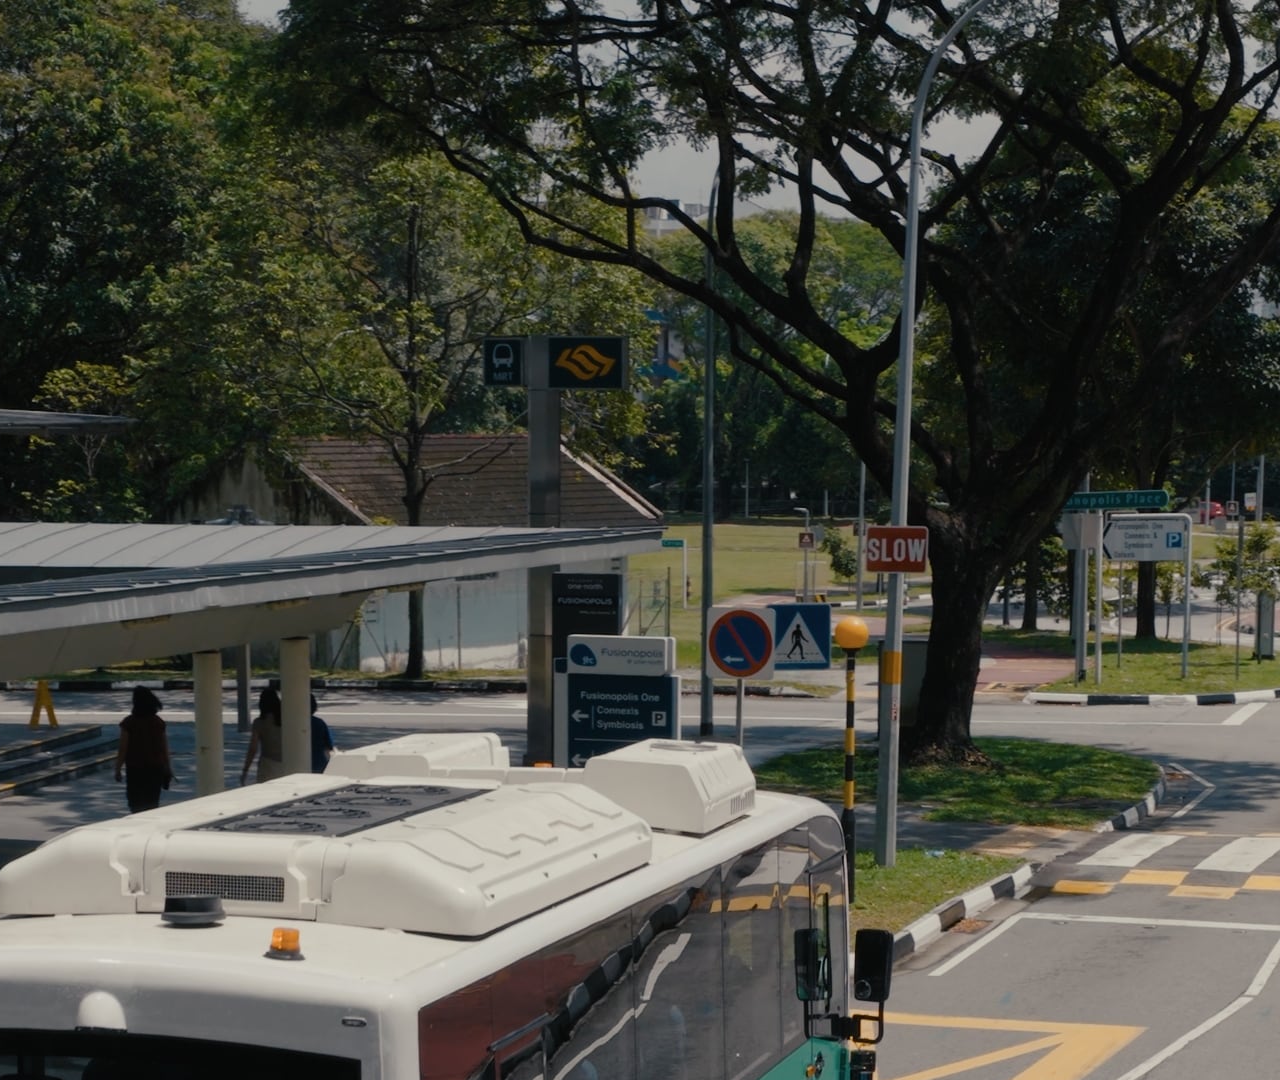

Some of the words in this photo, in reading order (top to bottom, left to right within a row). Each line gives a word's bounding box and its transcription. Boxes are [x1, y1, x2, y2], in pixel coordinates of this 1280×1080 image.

[493, 372, 513, 381] MRT
[1125, 493, 1162, 504] Place
[1168, 534, 1180, 547] P
[868, 537, 926, 562] SLOW
[557, 597, 613, 606] FUSIONOPOLIS
[601, 648, 663, 659] Fusionopolis
[580, 691, 639, 703] Fusionopolis
[641, 692, 660, 702] One
[596, 705, 639, 716] Connexis
[654, 713, 663, 724] P
[596, 720, 644, 731] Symbiosis
